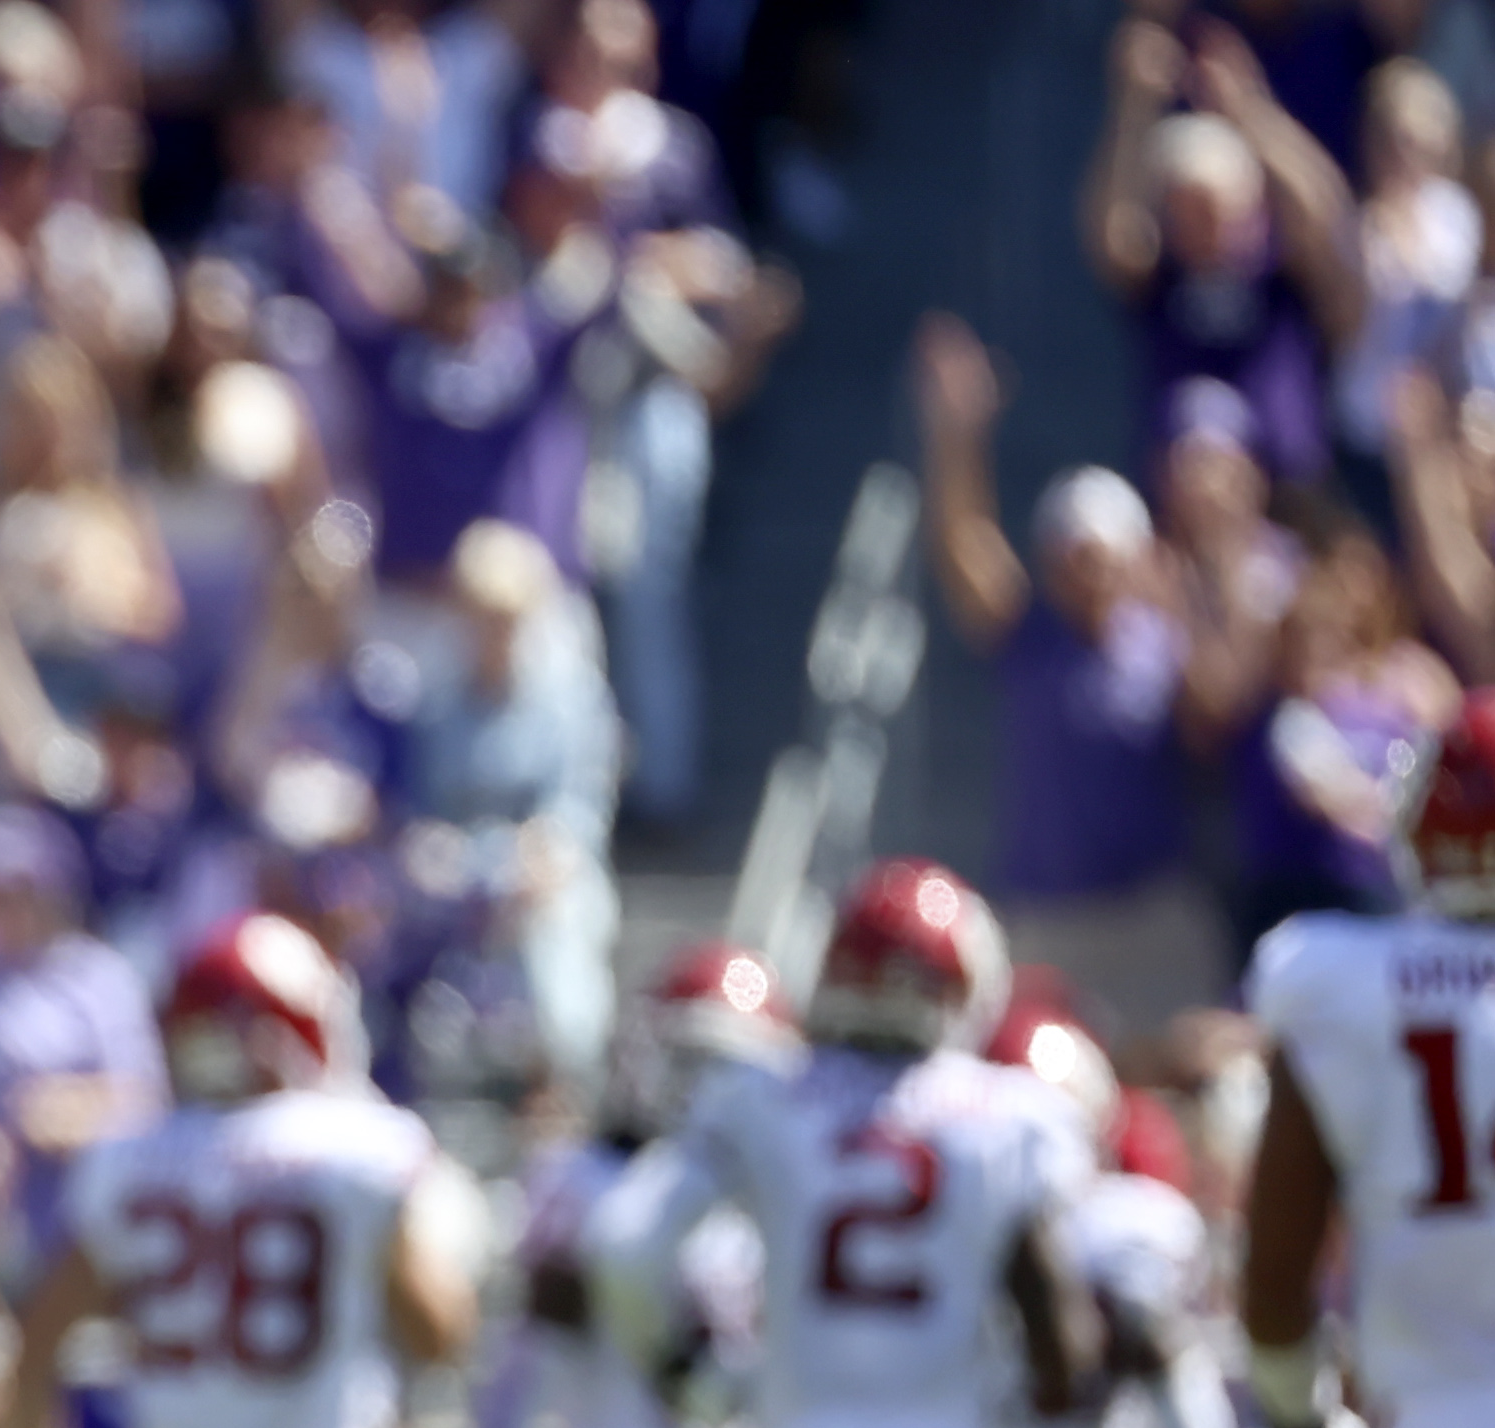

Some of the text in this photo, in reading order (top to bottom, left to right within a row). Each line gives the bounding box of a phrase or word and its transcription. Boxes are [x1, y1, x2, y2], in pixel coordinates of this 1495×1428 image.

[821, 1124, 945, 1308] 2
[1398, 1024, 1495, 1220] 1
[115, 1186, 325, 1378] 28
